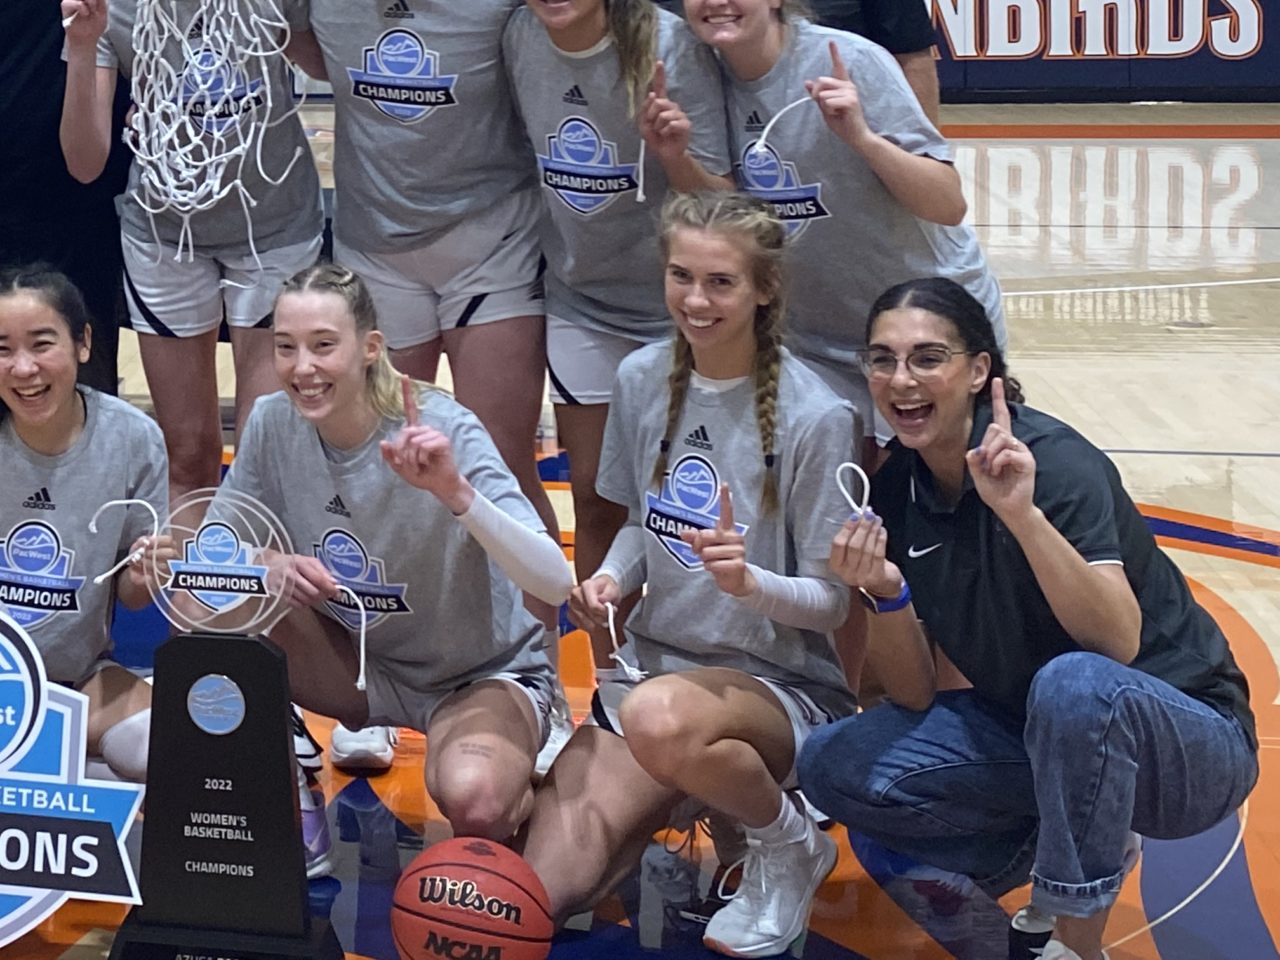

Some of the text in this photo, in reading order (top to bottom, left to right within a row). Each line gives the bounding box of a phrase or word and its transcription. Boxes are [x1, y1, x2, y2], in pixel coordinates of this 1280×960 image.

[359, 84, 446, 102] CHAMPIONS
[545, 171, 629, 191] CHAMPIONS
[774, 201, 817, 216] PIONS
[178, 574, 259, 591] CHAMPIONS
[204, 778, 233, 791] 2022
[190, 812, 247, 827] WOMEN'S
[184, 825, 254, 841] BASKETBALL
[184, 860, 254, 877] CHAMPIONS
[418, 877, 523, 926] Wilson
[423, 930, 503, 960] NCAA
